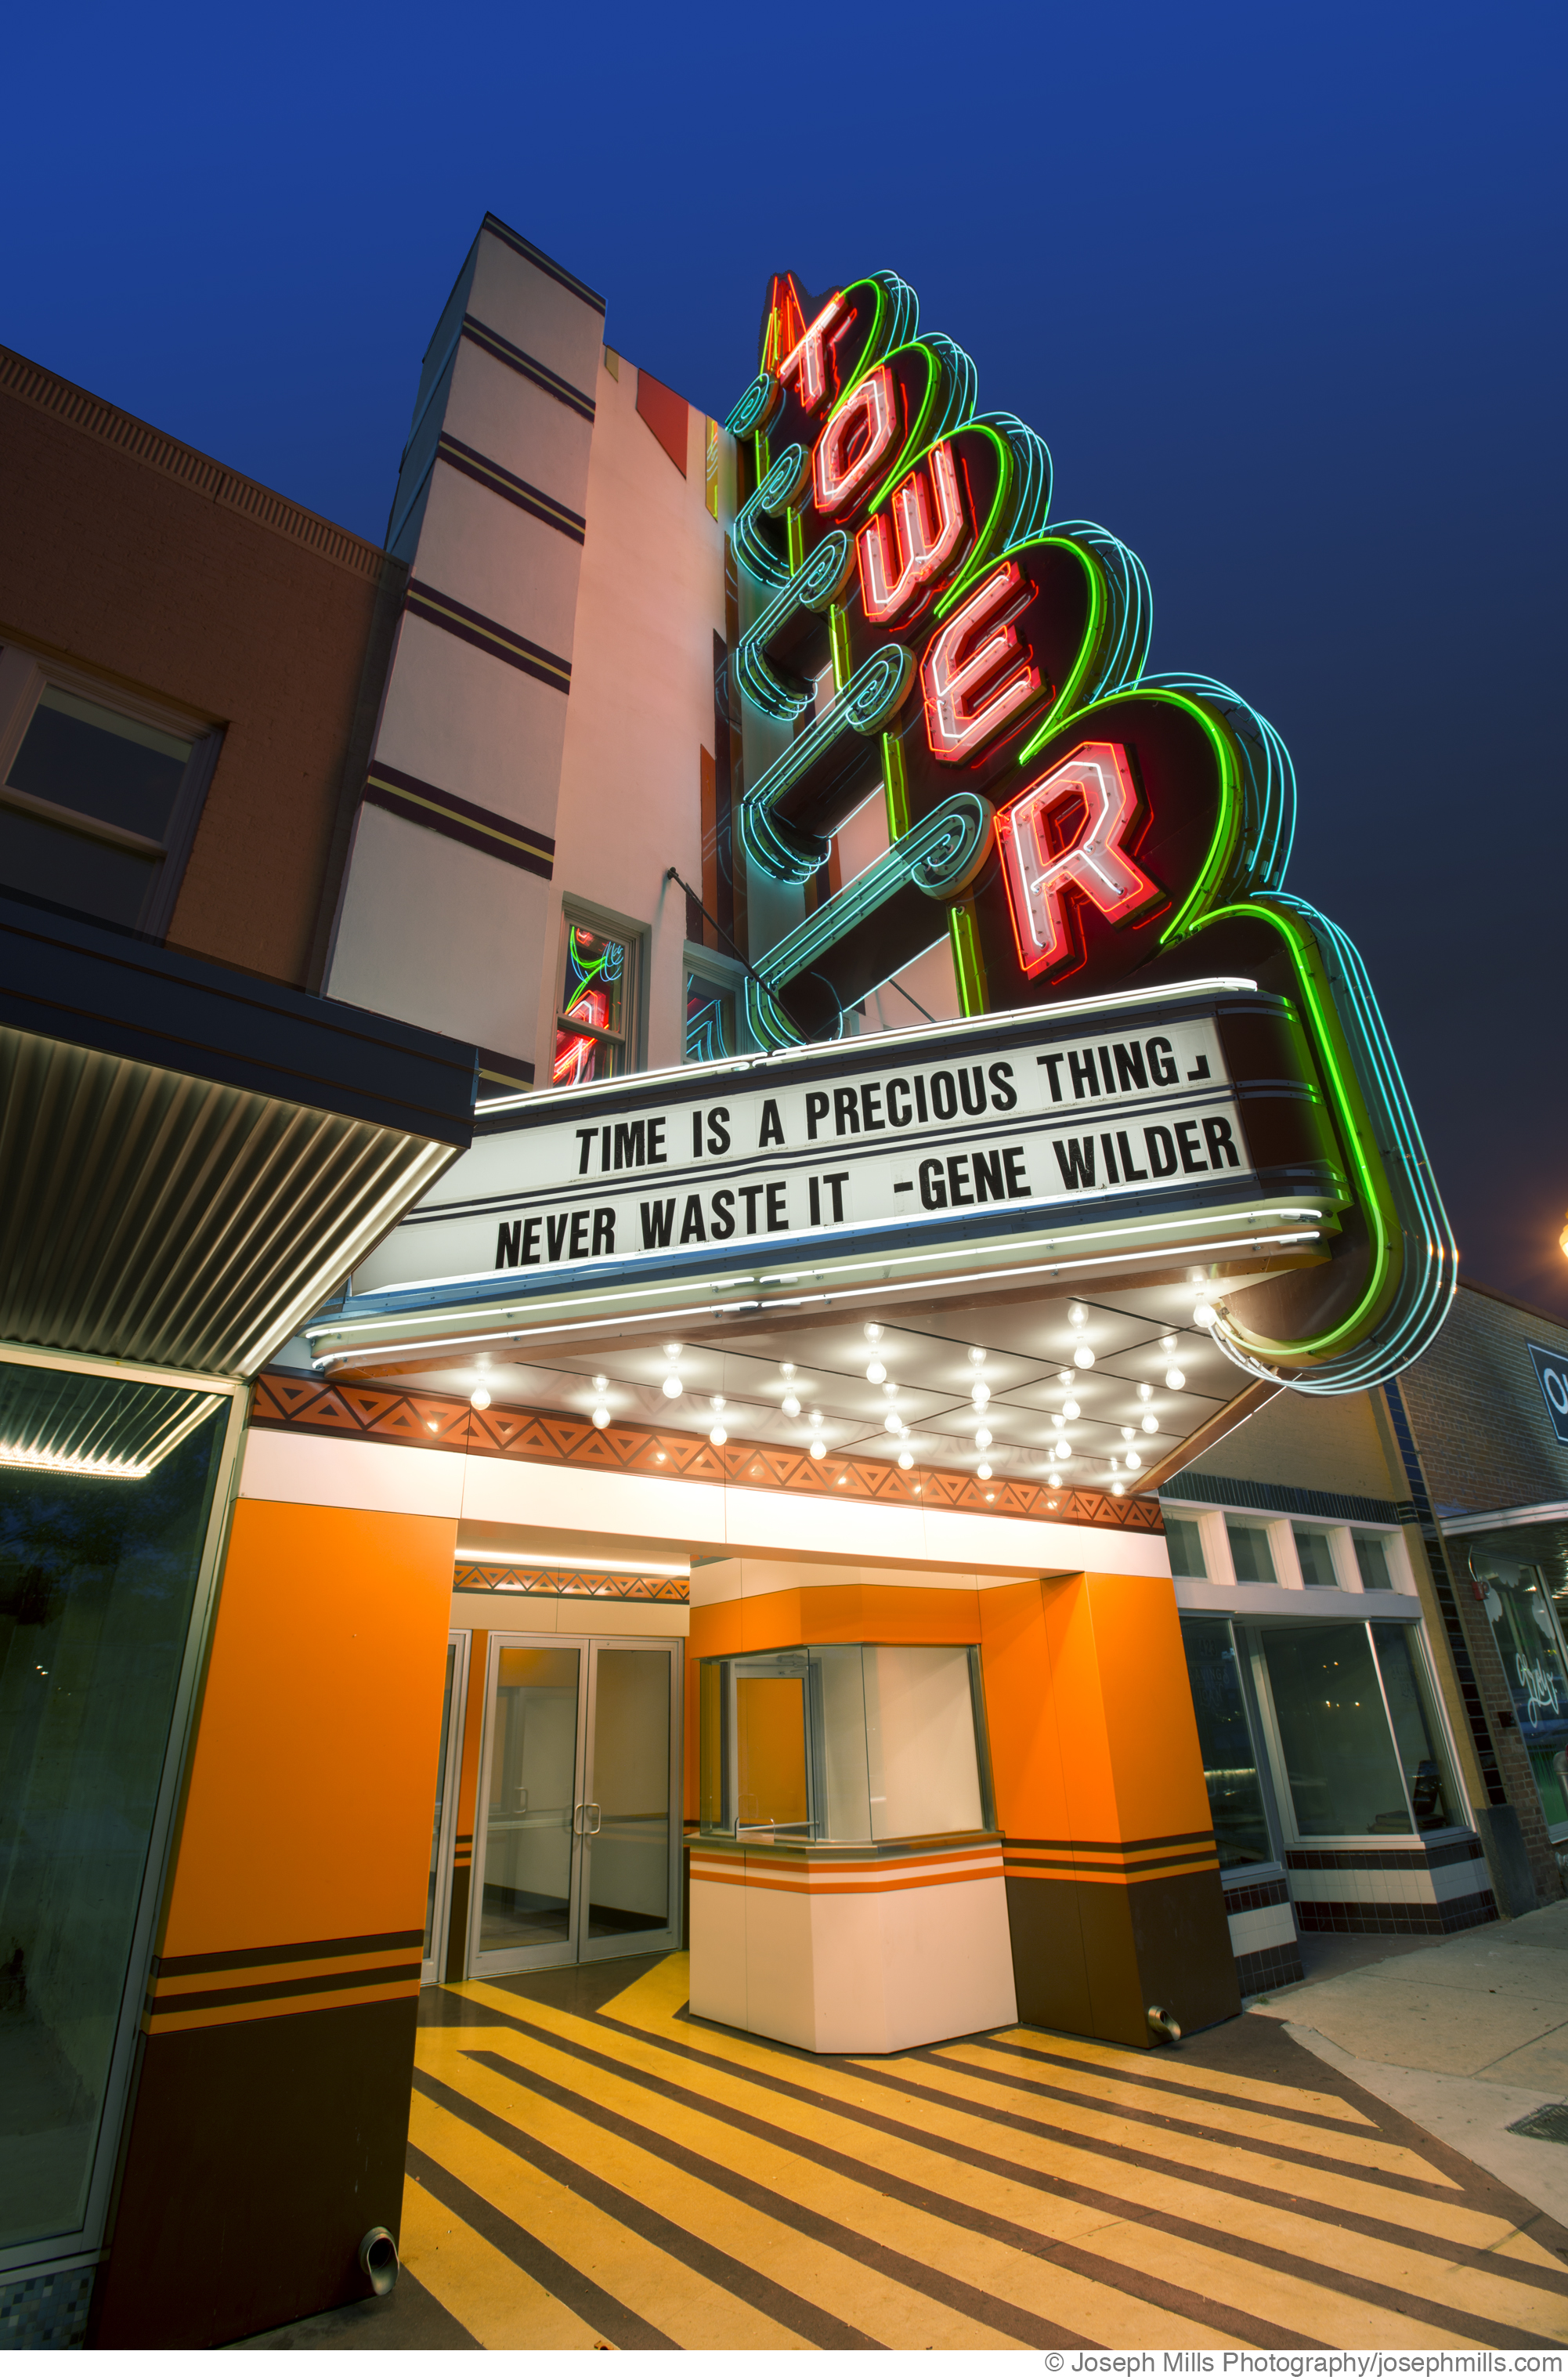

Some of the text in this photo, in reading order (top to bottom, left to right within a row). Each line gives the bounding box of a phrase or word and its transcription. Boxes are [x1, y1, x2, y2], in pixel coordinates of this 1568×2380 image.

[776, 290, 1169, 981] TOWER
[495, 1116, 1241, 1270] NEVER WASTE IT -GENE WILDER
[575, 1116, 667, 1174] TIME
[692, 1107, 731, 1158] IS
[758, 1098, 786, 1148] A
[805, 1062, 1017, 1140] PRECIOUS
